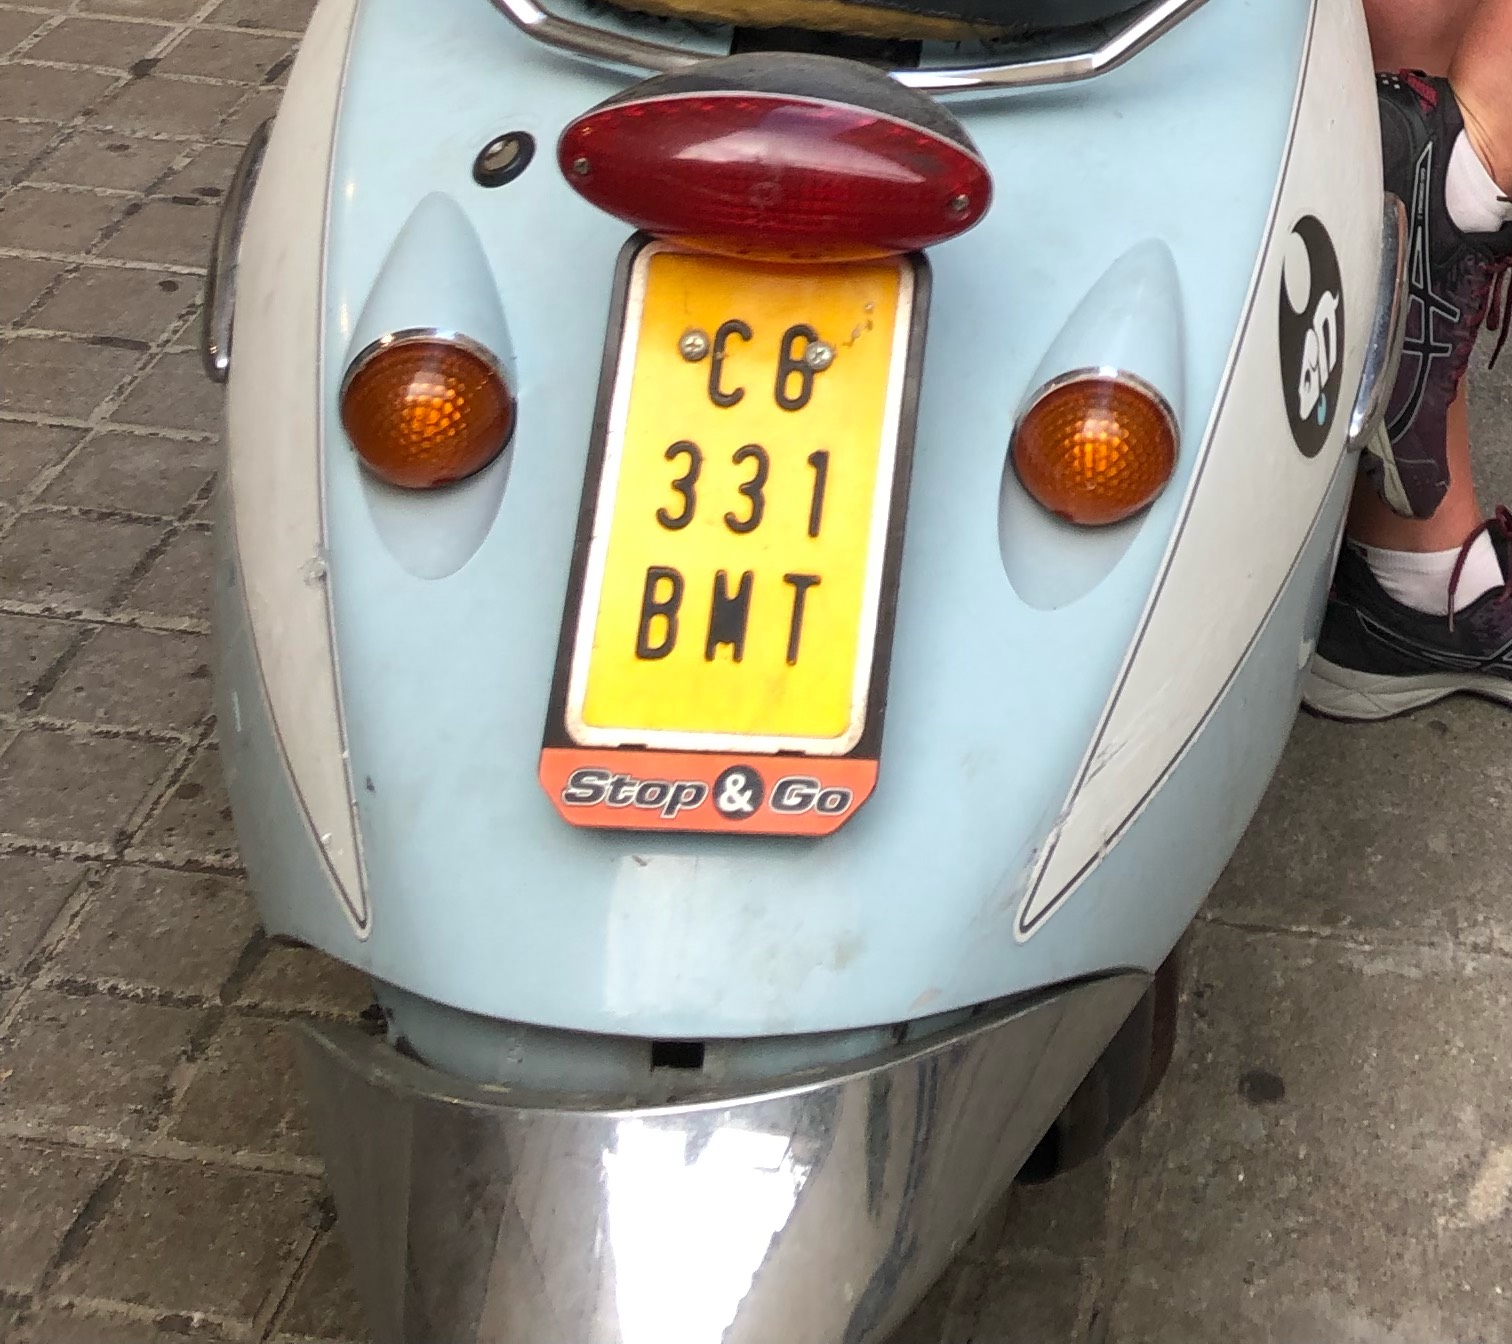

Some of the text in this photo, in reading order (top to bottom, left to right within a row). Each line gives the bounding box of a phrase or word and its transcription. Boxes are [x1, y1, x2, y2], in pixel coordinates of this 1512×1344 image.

[655, 439, 832, 540] 331
[562, 767, 854, 820] Stop & Go
